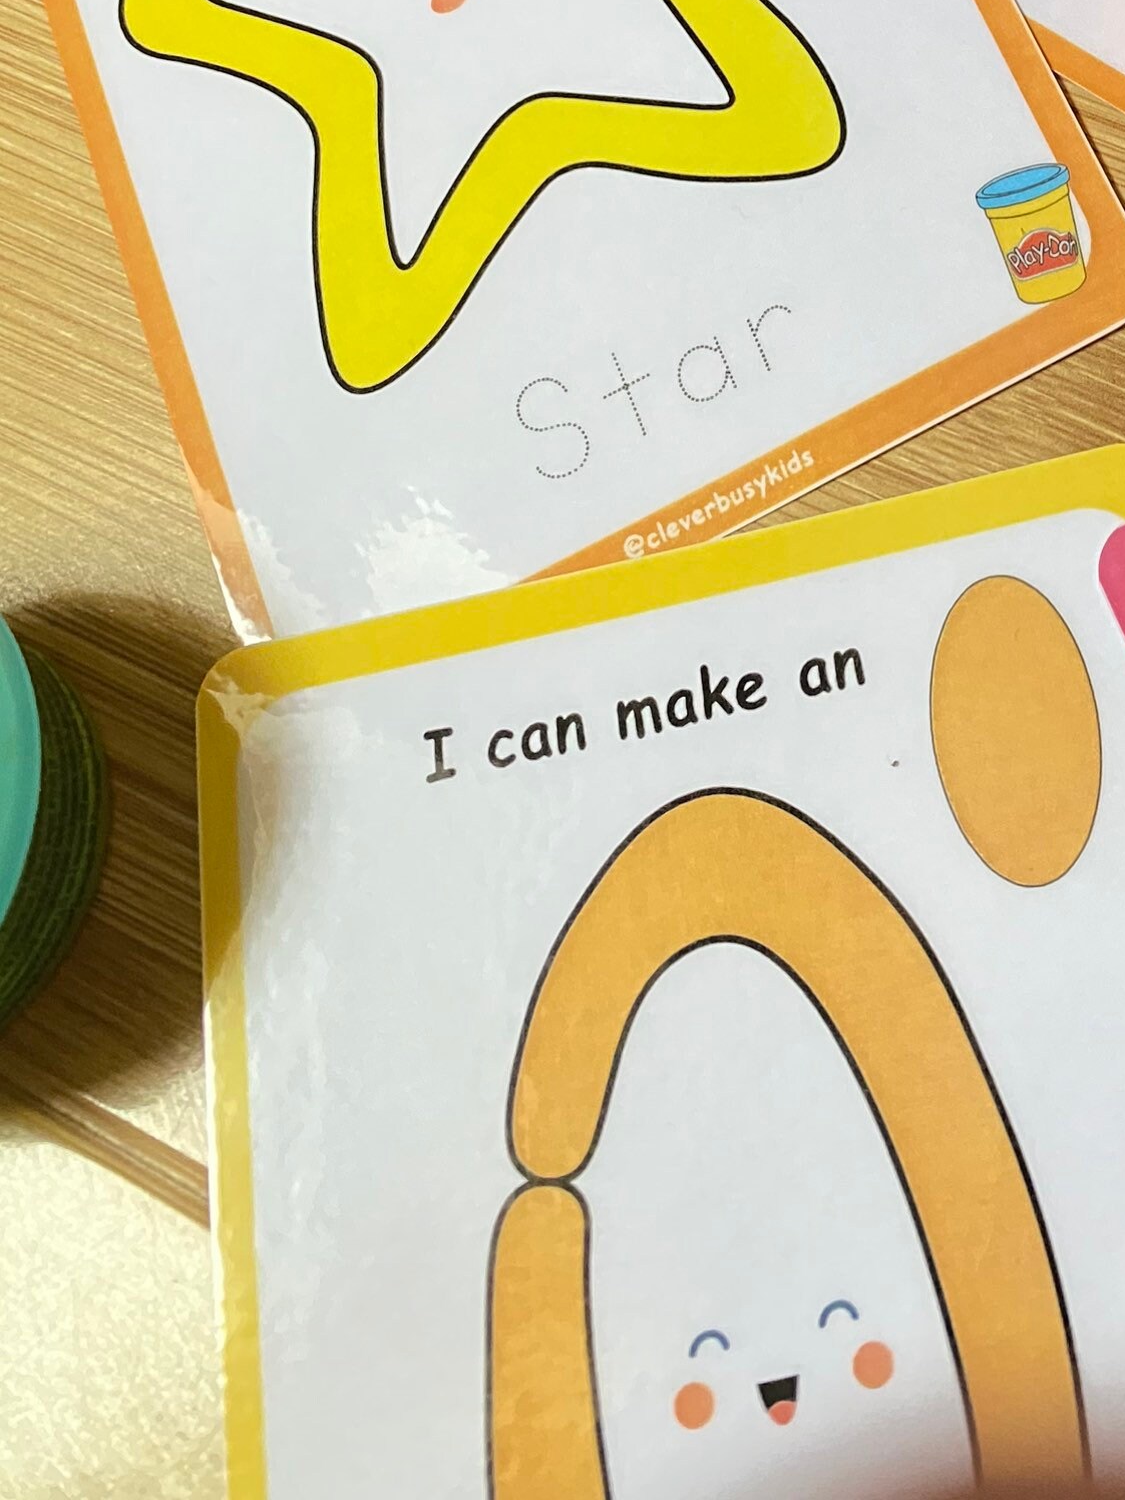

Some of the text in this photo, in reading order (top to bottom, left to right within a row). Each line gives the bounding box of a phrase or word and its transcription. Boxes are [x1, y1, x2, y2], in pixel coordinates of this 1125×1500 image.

[516, 304, 792, 479] Star
[623, 450, 814, 560] @cleverbusykids
[423, 647, 867, 784] I can make an
